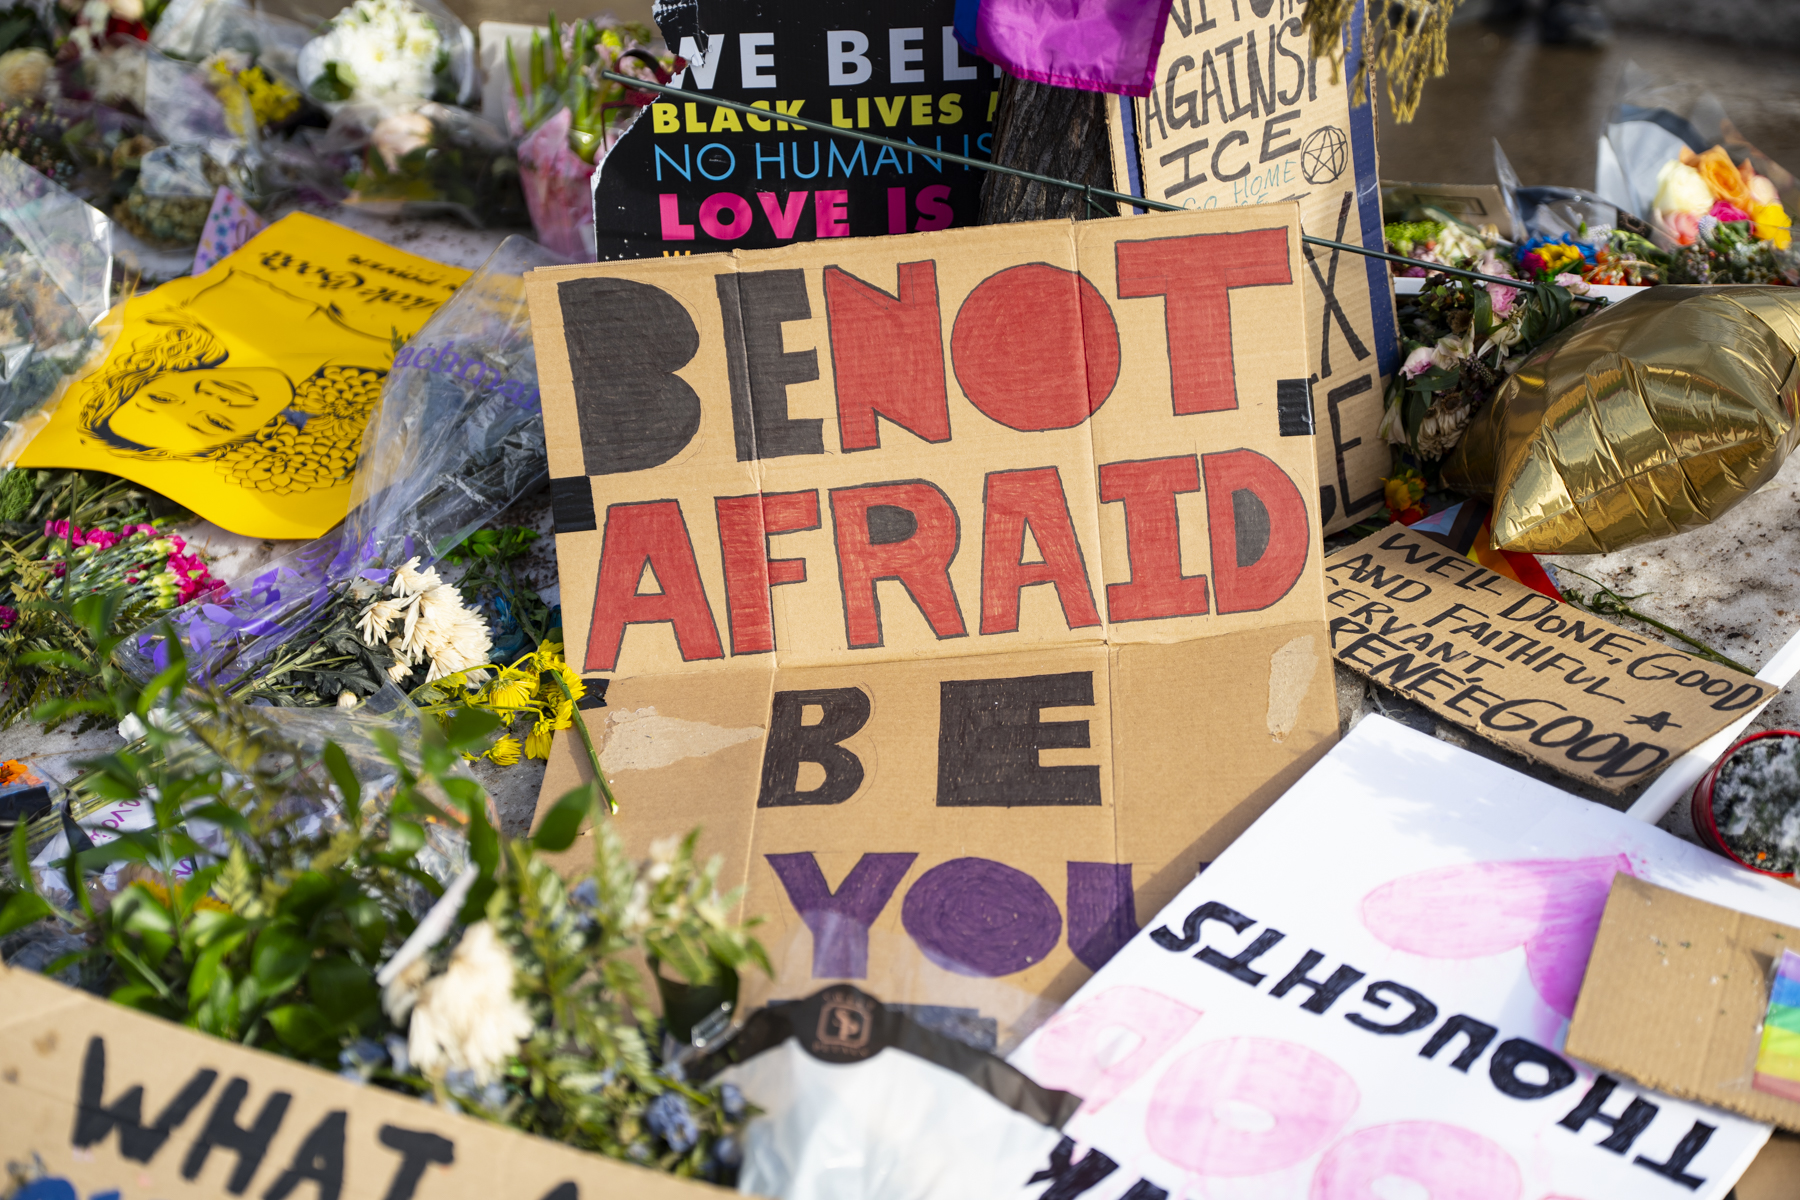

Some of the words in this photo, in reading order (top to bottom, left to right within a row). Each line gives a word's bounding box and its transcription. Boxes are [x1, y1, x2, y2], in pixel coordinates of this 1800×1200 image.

[652, 100, 808, 134] BLACK
[831, 93, 963, 129] LIVES
[666, 32, 777, 89] WE
[654, 143, 737, 182] NO
[755, 134, 943, 181] HUMAN
[1159, 109, 1302, 200] ICE
[1233, 158, 1297, 204] HOME
[658, 189, 850, 241] LOVE
[887, 185, 954, 234] IS
[583, 447, 1310, 673] AFRAID
[1325, 552, 1432, 603] AND
[1422, 603, 1626, 704] FAITHFUL
[1378, 532, 1502, 596] WELL
[1627, 653, 1764, 711] GOOD
[757, 671, 1103, 808] BE
[1479, 698, 1670, 778] GOOD
[1034, 983, 1590, 1200] OOD
[1150, 900, 1718, 1191] THOUGHTS
[71, 1035, 455, 1200] WHAT
